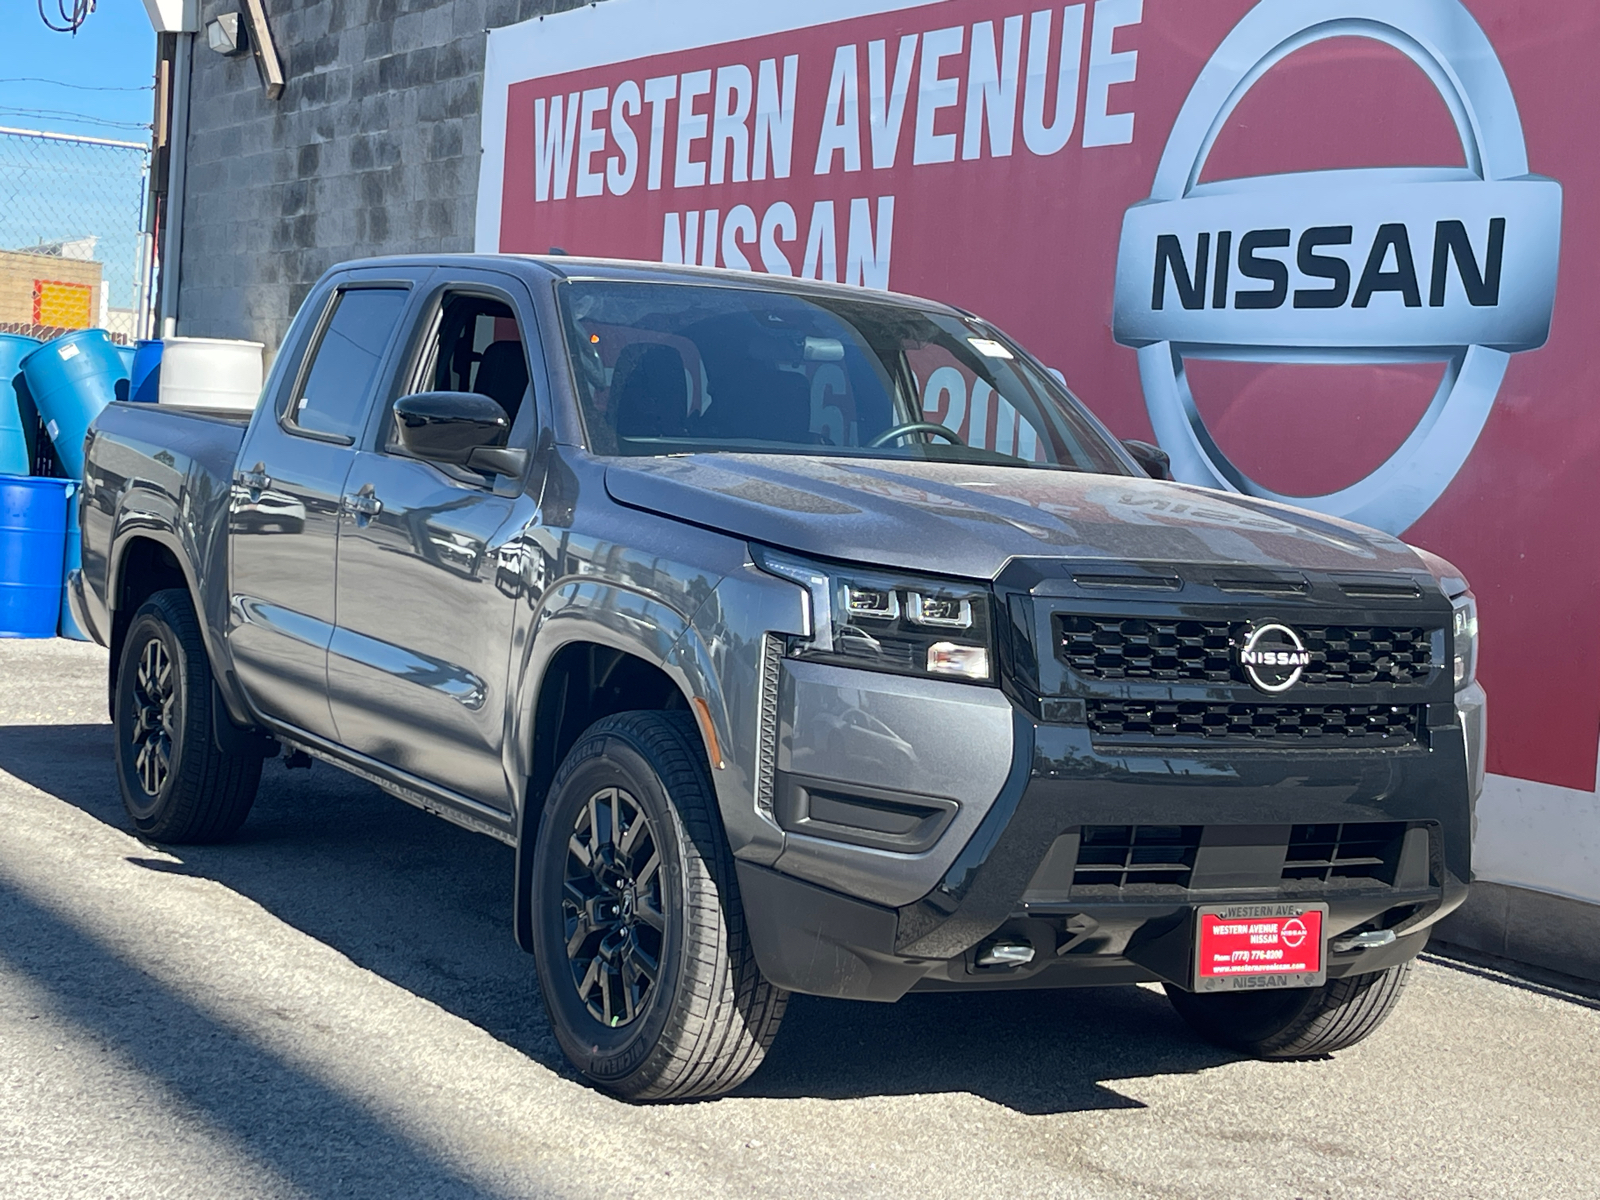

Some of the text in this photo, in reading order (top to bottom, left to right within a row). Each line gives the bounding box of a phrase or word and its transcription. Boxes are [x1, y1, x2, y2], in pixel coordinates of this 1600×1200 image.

[534, 0, 1144, 203] WESTERN AVENUE
[1151, 217, 1506, 310] NISSAN
[1241, 652, 1308, 664] NISSAN
[1228, 905, 1295, 917] WESTERN AVE
[1213, 924, 1278, 935] WESTERN AVENUE
[1251, 934, 1278, 943] NISSAN
[1233, 976, 1288, 988] NISSAN
